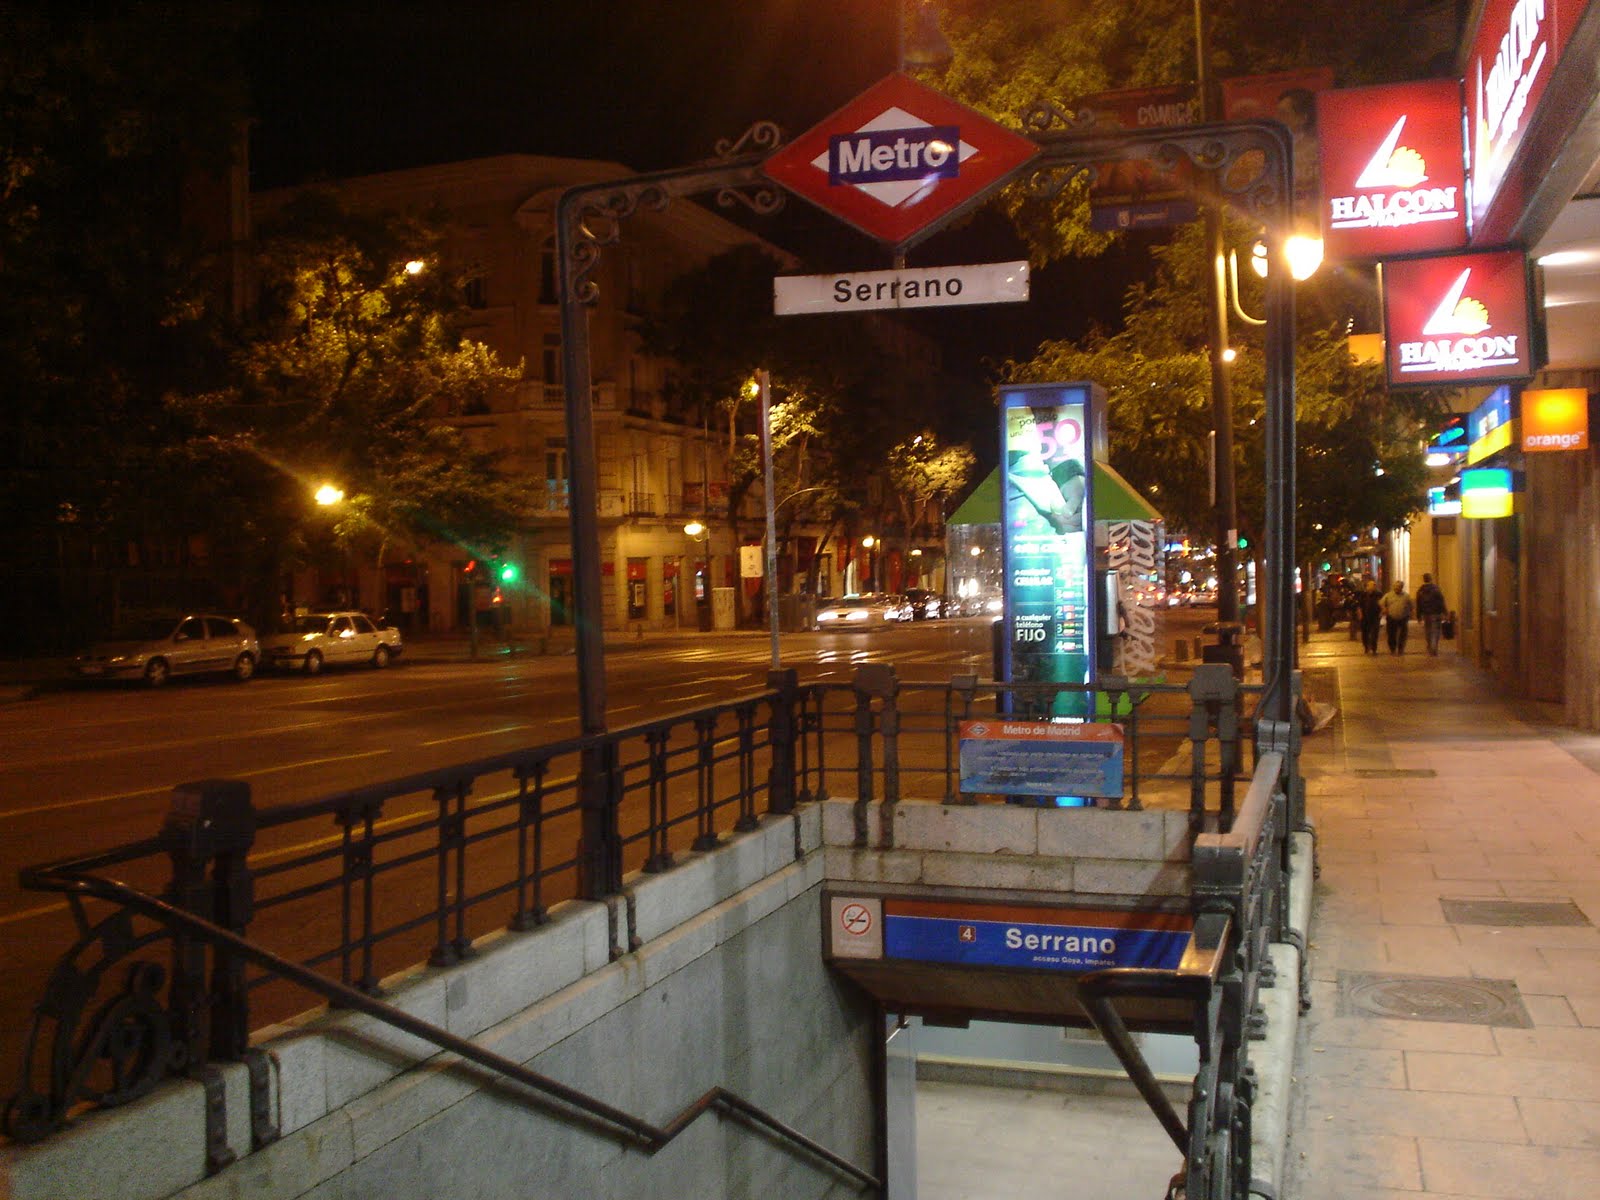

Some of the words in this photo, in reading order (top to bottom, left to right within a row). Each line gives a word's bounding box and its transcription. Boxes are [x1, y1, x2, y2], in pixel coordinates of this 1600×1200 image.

[838, 137, 949, 174] Metro
[1330, 187, 1458, 219] HALCON
[833, 277, 963, 303] Serrano
[1399, 335, 1519, 363] HALCON
[1526, 433, 1580, 448] orange
[1017, 629, 1046, 641] FIJO
[1003, 724, 1031, 735] Metro
[1033, 725, 1046, 735] de
[1048, 725, 1081, 736] Madrid
[962, 928, 973, 941] 4
[1005, 928, 1116, 955] Serrano
